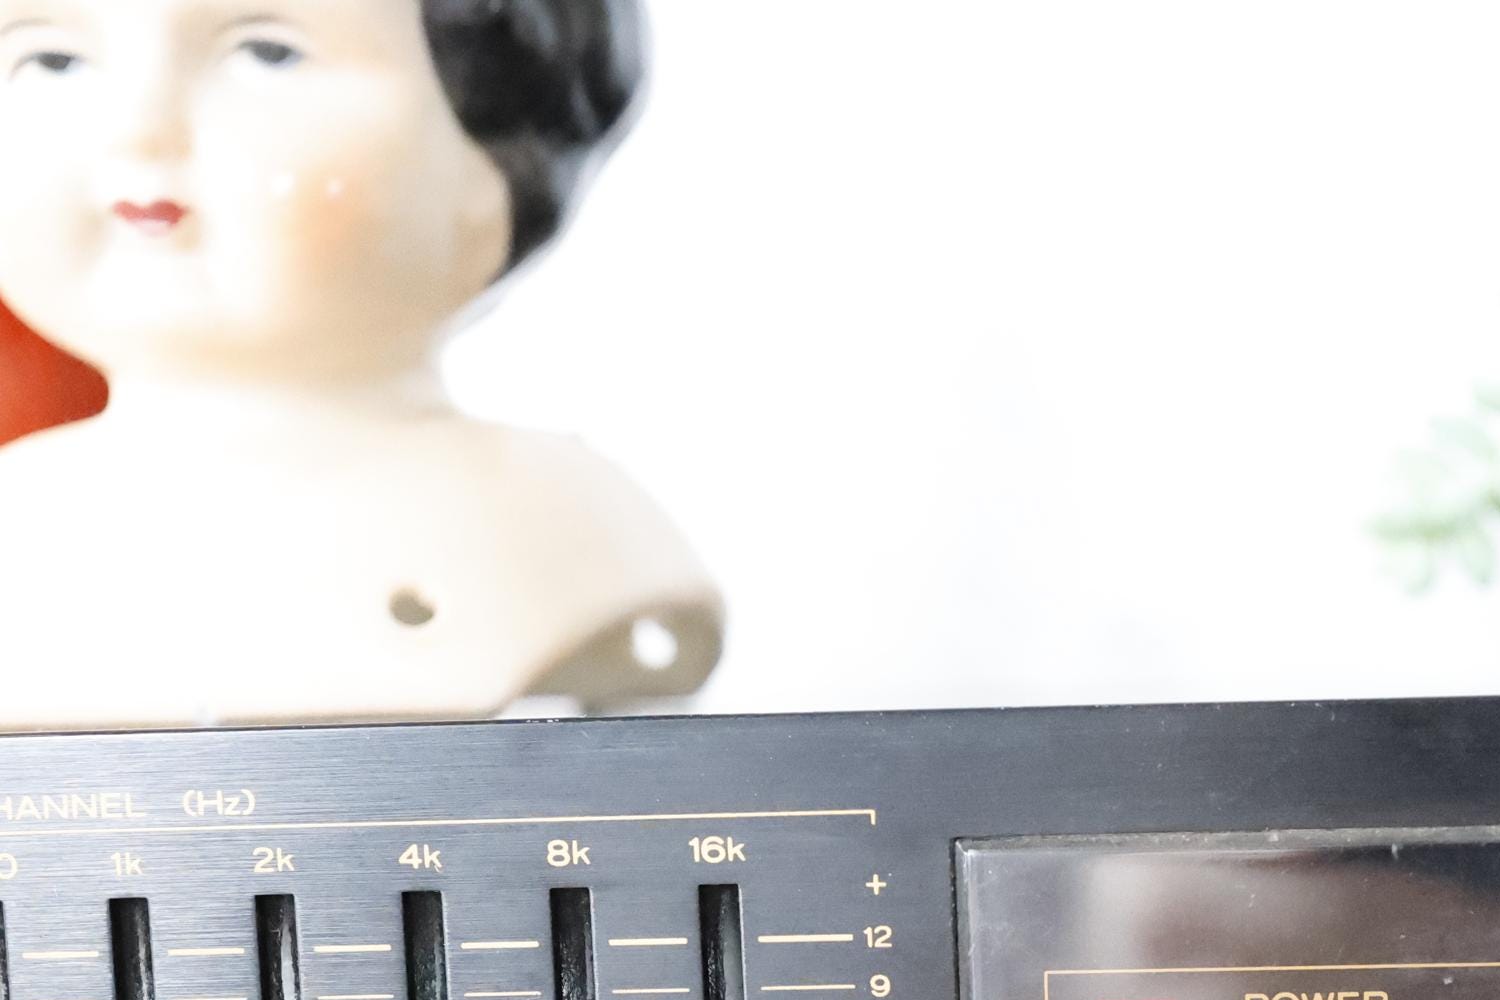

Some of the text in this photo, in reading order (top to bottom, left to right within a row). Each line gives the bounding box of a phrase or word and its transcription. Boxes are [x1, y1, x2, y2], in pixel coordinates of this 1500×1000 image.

[181, 789, 256, 817] (Hz)
[111, 852, 143, 877] 1k
[253, 847, 294, 873] 2k
[399, 844, 442, 871] 4k
[547, 840, 590, 867] 8k
[689, 836, 745, 863] 16k
[864, 925, 892, 948] 12
[870, 974, 891, 997] 9
